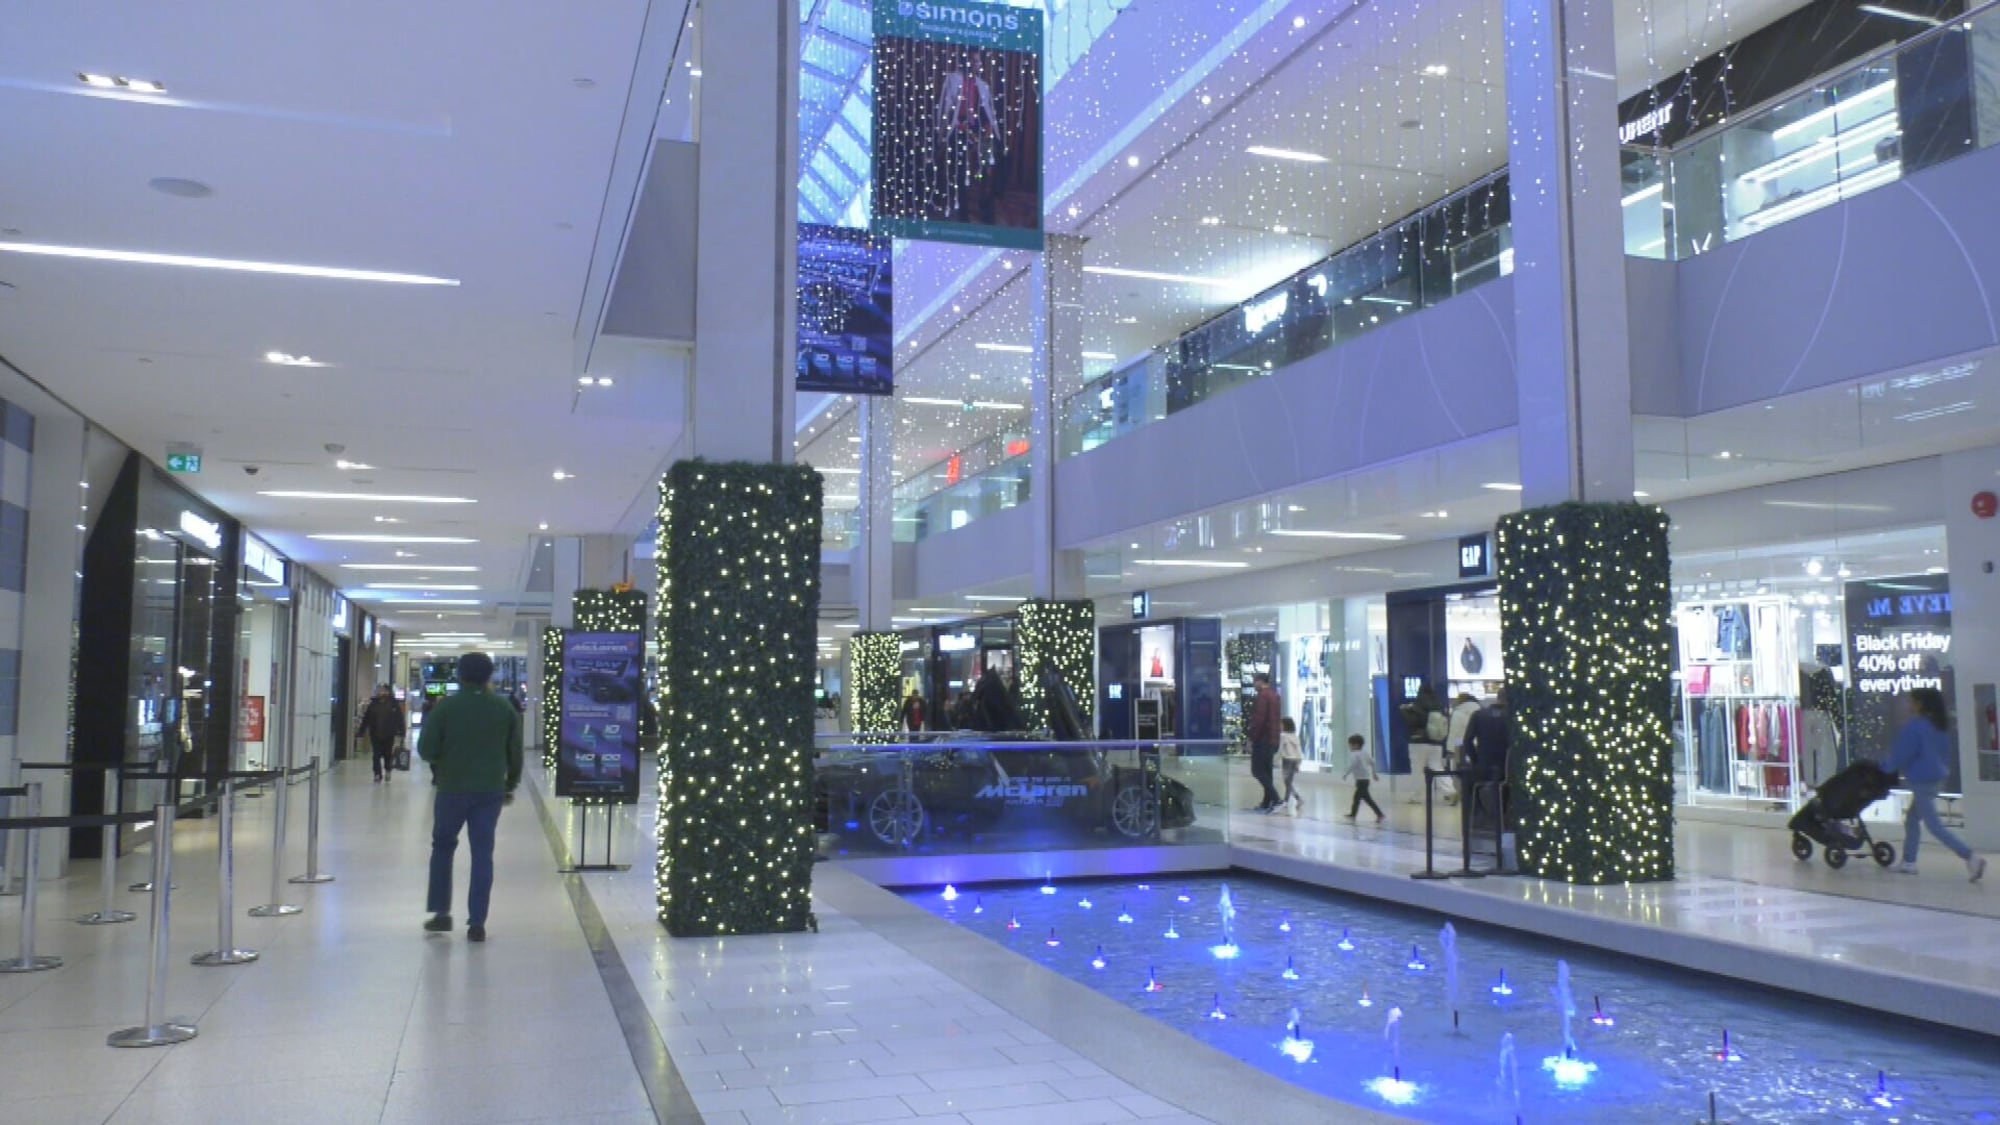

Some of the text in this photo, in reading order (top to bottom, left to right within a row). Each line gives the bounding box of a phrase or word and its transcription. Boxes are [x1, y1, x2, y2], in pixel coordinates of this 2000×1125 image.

[1856, 632, 1951, 652] Black Friday
[1858, 653, 1921, 671] 40% off
